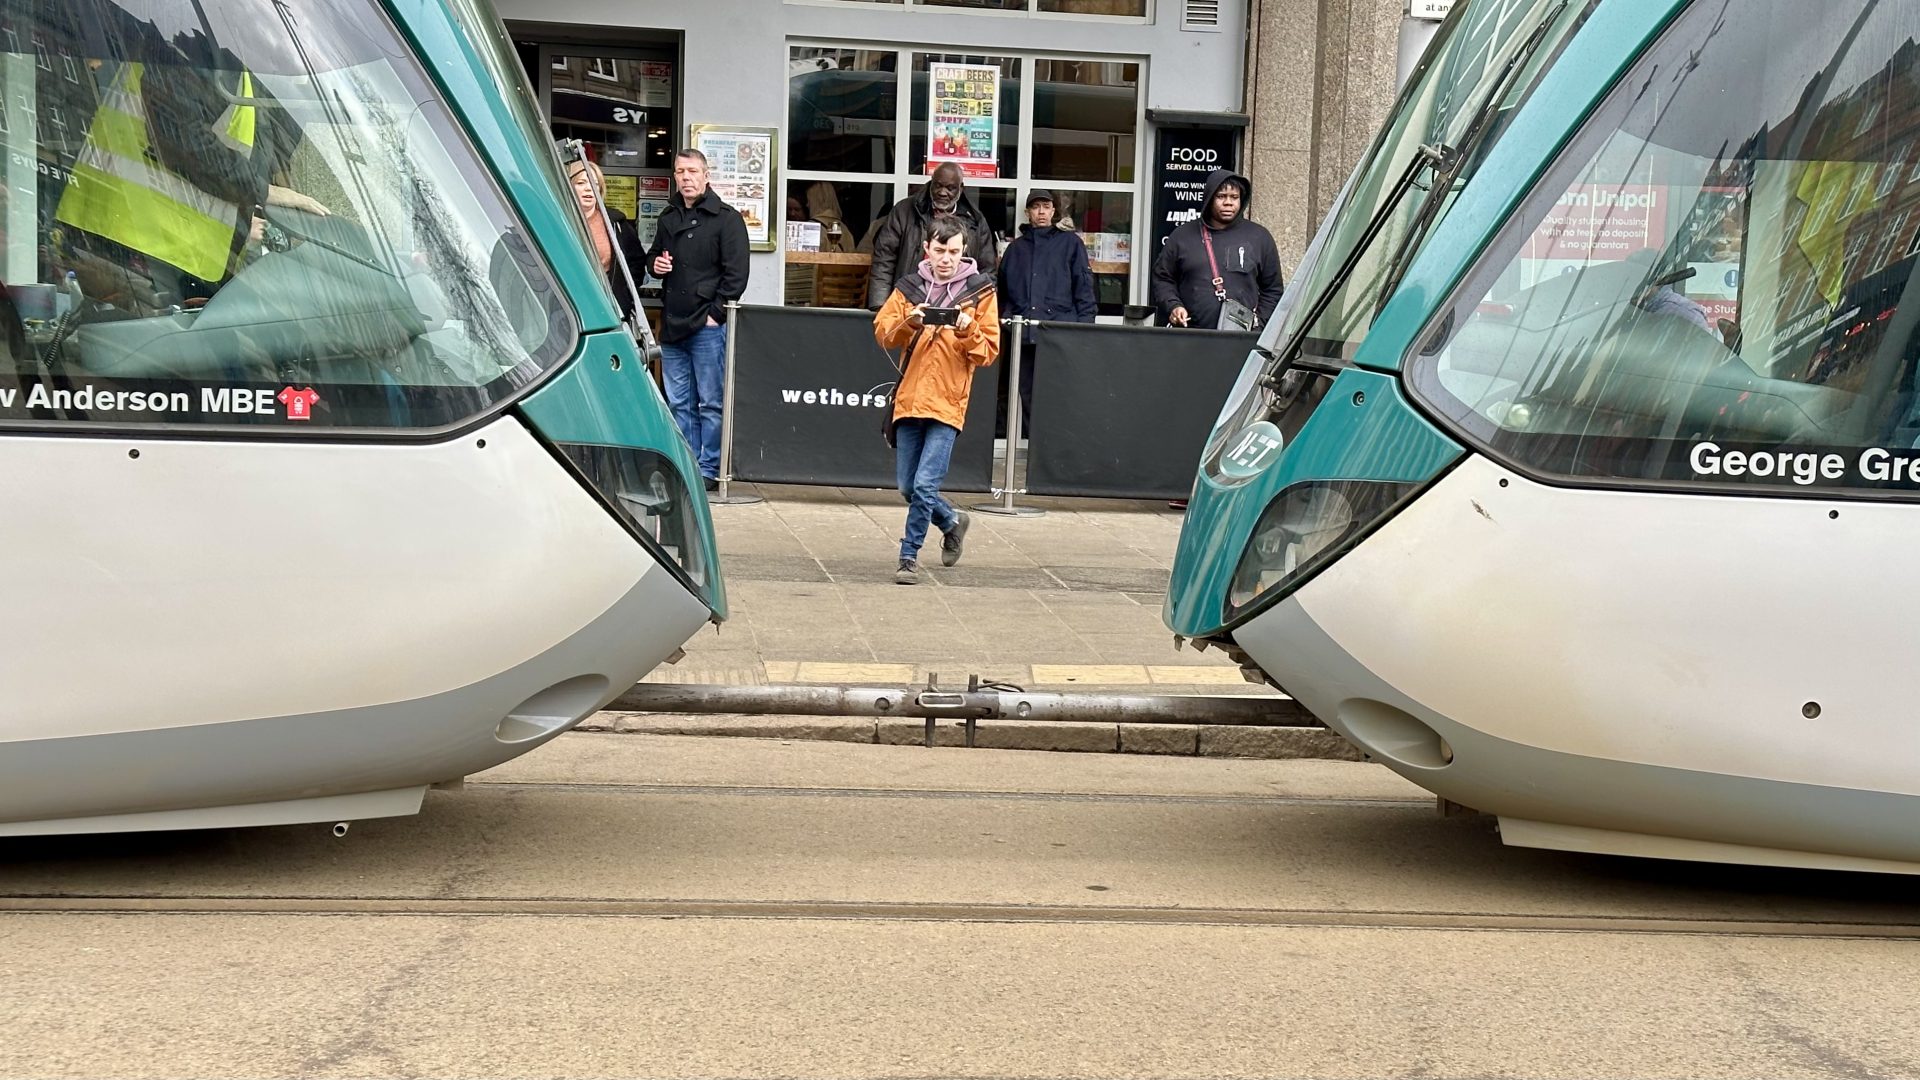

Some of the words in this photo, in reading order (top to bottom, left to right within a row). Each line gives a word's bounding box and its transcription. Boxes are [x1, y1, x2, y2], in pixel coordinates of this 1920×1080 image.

[936, 68, 966, 80] CRAFT
[966, 69, 994, 80] BEERS
[935, 116, 971, 124] SPRITZ
[1171, 147, 1218, 162] FOOD
[1165, 163, 1193, 171] SERVED
[1164, 181, 1189, 189] AWARD
[1175, 191, 1204, 201] WINE
[1593, 190, 1657, 212] Unipol
[1543, 215, 1577, 226] Quality
[1578, 216, 1610, 225] student
[1611, 216, 1648, 227] housing
[1563, 229, 1575, 237] no
[1599, 230, 1611, 238] no
[1580, 239, 1629, 250] guarantors
[26, 384, 189, 412] Anderson
[201, 387, 276, 414] MBE
[782, 388, 893, 408] wethers
[1690, 441, 1845, 485] George
